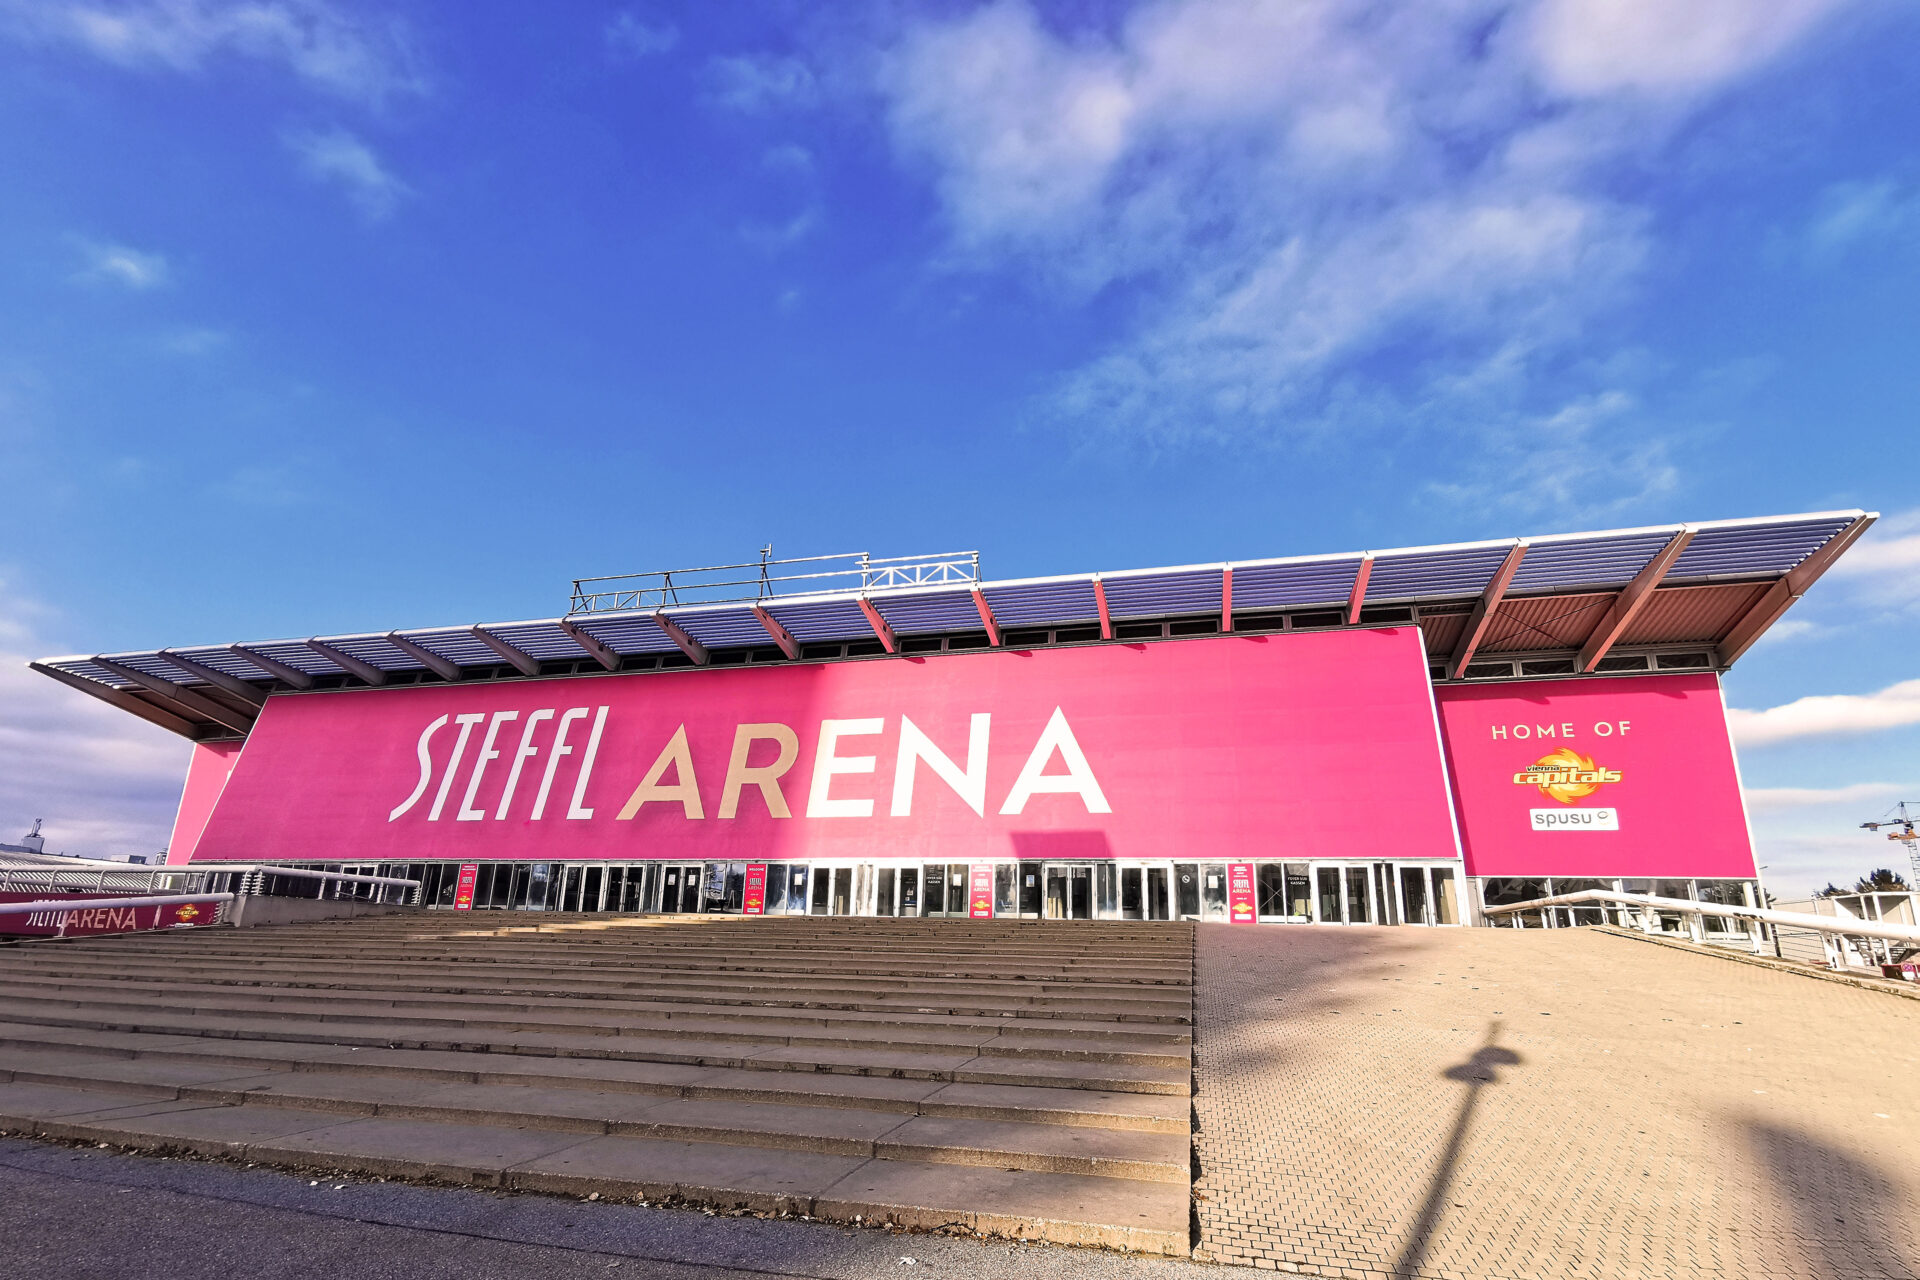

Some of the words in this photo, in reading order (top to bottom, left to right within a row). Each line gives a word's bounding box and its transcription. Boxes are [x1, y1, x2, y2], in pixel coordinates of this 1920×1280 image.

[1491, 722, 1575, 740] HOME
[1594, 721, 1631, 737] OF
[389, 705, 610, 822] STEFFL
[616, 705, 1113, 820] ARENA
[1526, 764, 1561, 772] vienna
[1513, 767, 1622, 788] capitals
[1535, 813, 1592, 828] spusu
[65, 907, 137, 930] ARENA
